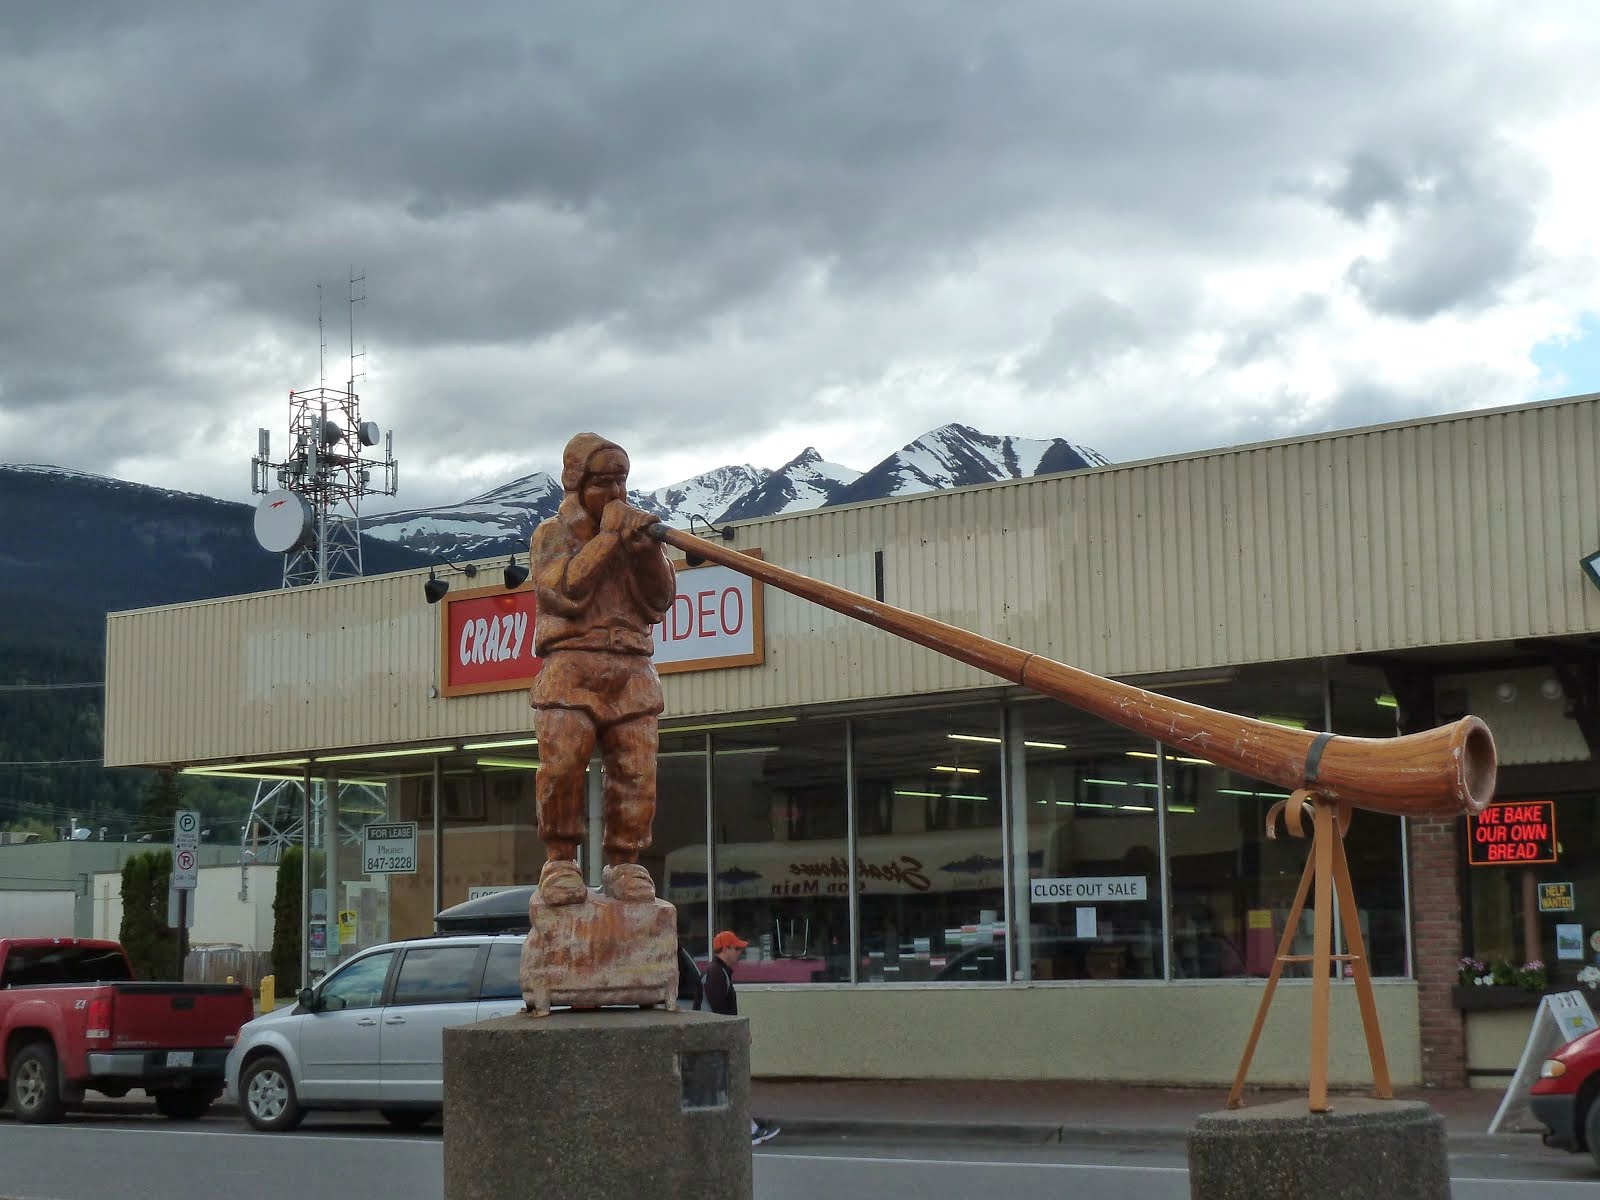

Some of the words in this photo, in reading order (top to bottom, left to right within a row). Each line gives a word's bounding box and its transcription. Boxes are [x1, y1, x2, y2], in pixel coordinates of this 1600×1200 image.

[460, 611, 528, 666] CRAZY
[649, 586, 744, 642] IDEO
[1478, 807, 1500, 824] WE
[1504, 806, 1542, 822] BAKE
[371, 829, 388, 838] FOR
[389, 827, 411, 838] LEASE
[1476, 826, 1507, 842] OUR
[1510, 824, 1548, 841] OWN
[1488, 842, 1538, 860] BREAD
[367, 856, 412, 870] 847-3228
[1034, 884, 1058, 896] CLOSE
[1076, 884, 1103, 896] OUT
[1107, 883, 1138, 895] SALE
[1545, 885, 1567, 896] HELP
[1541, 897, 1572, 909] WANTED
